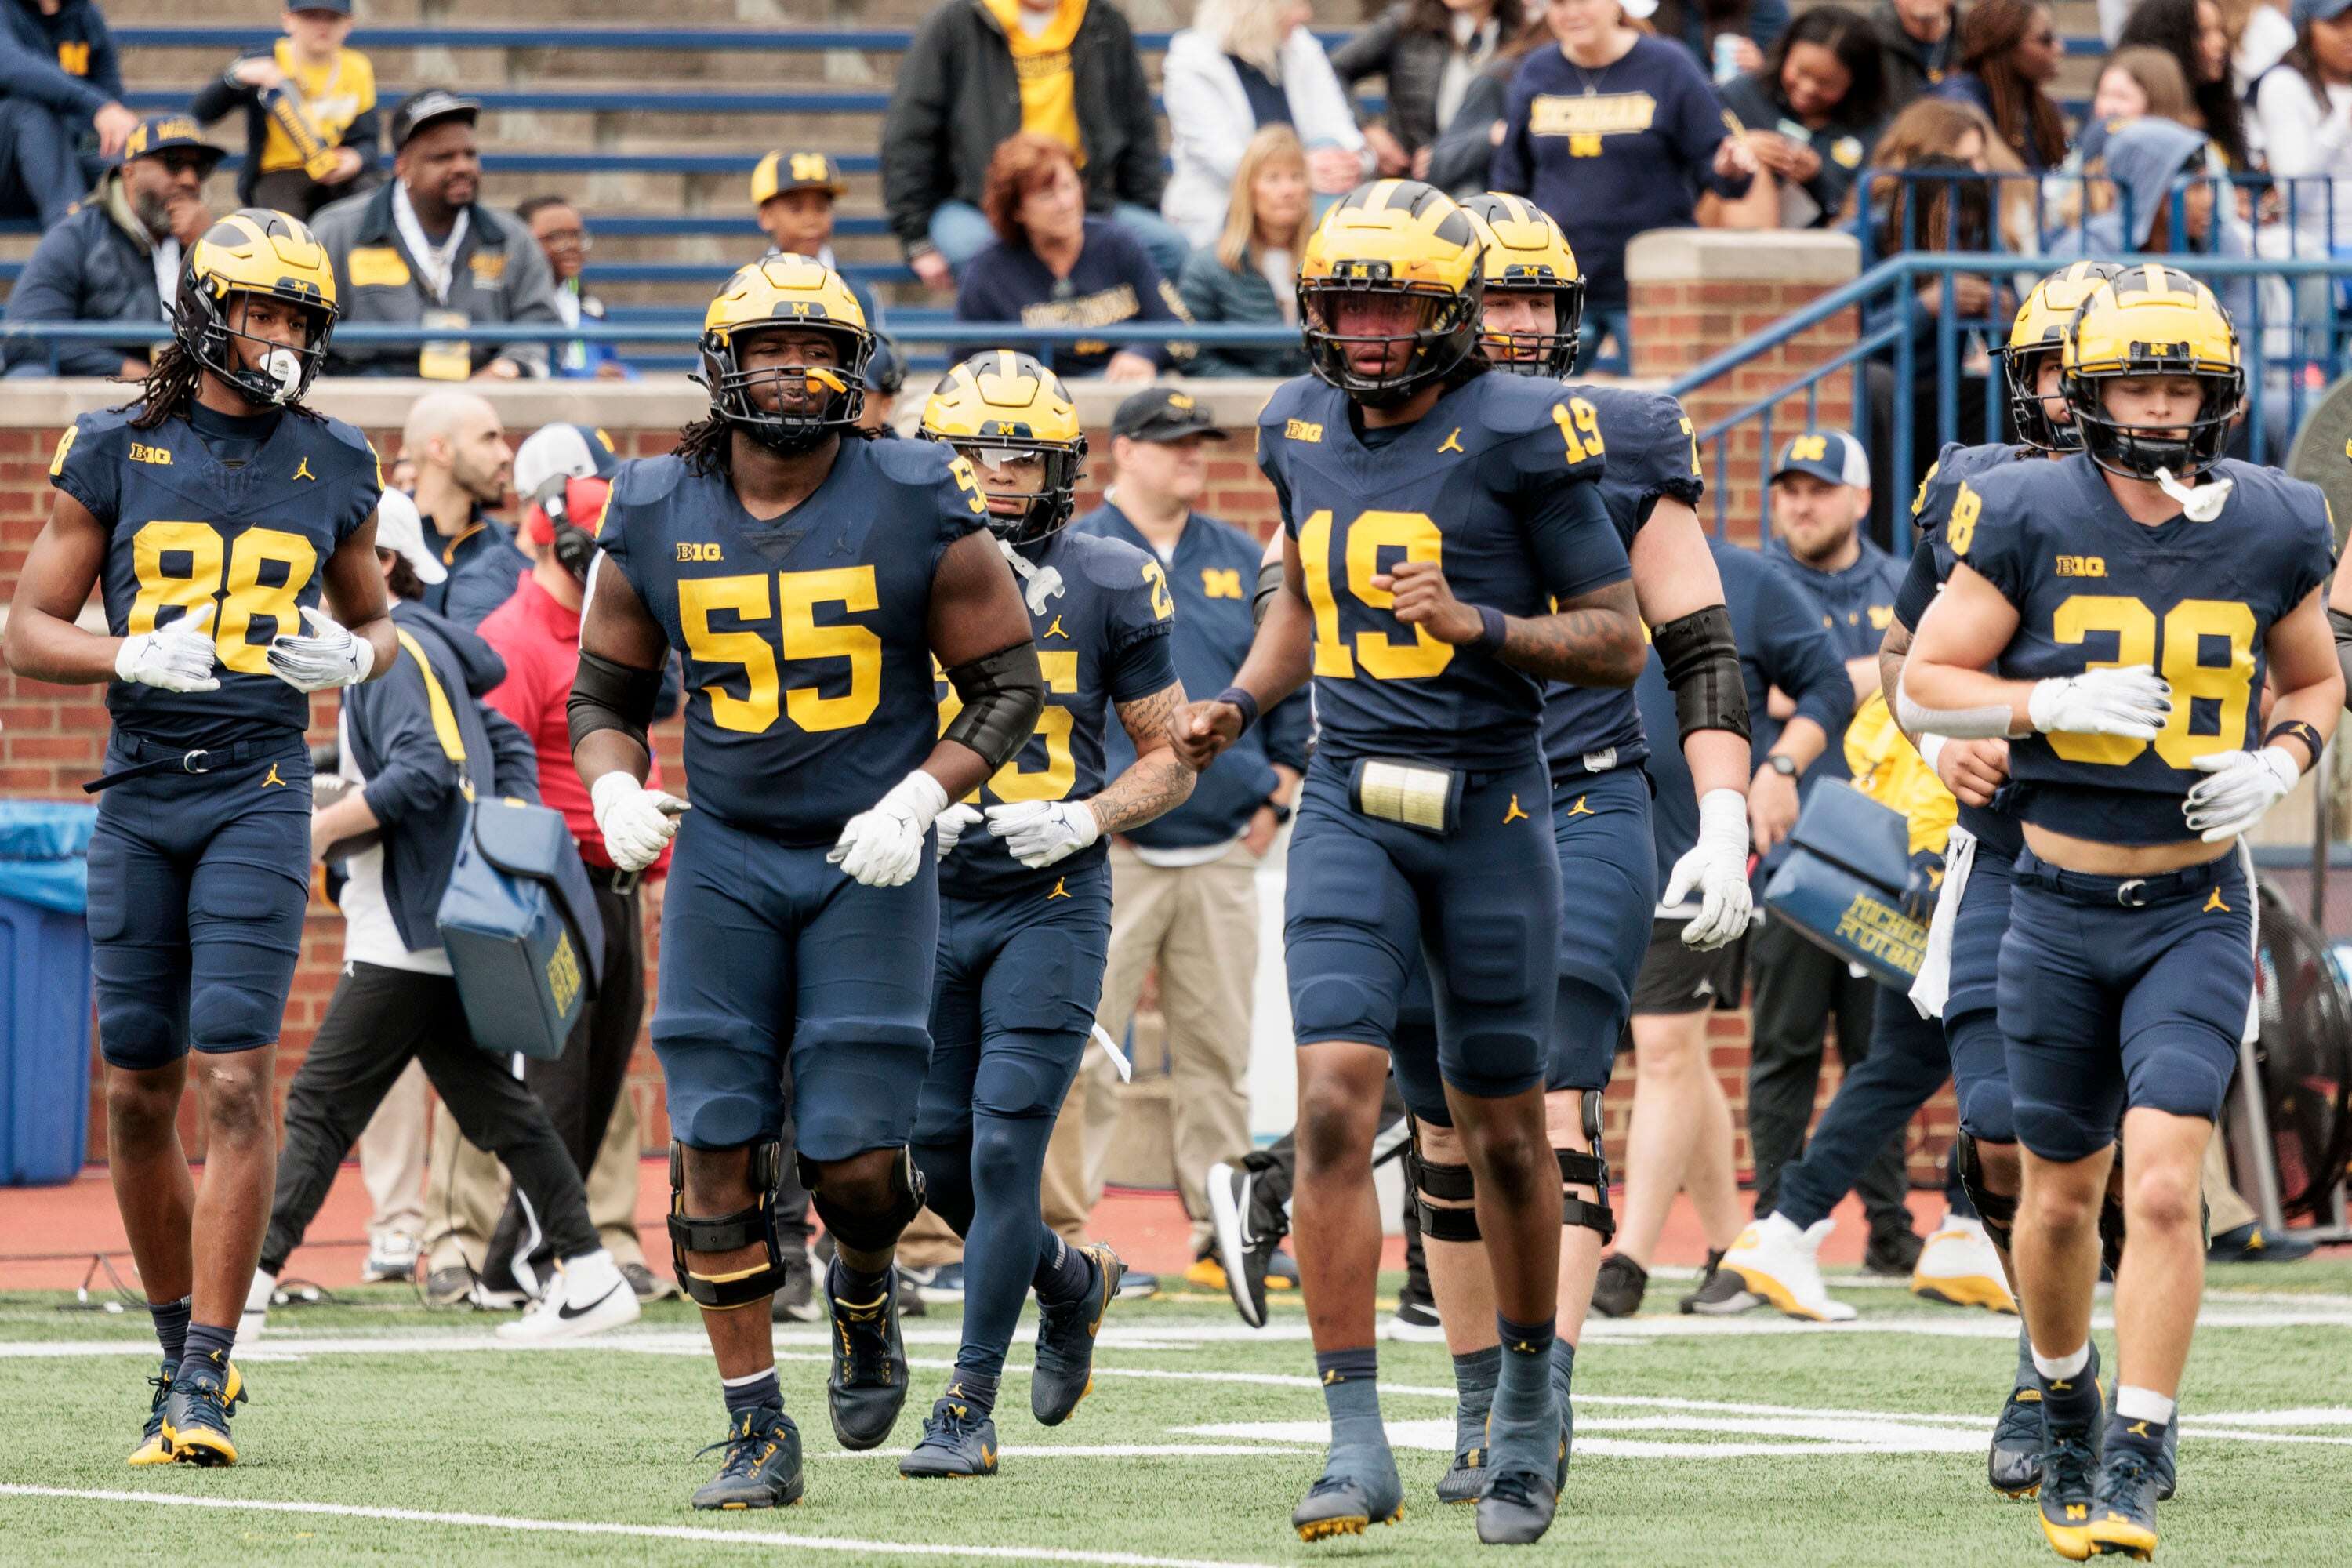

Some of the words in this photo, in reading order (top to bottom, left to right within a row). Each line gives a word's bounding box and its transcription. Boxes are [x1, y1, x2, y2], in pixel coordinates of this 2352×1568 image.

[790, 152, 829, 181] M
[1351, 265, 1368, 278] M
[1522, 265, 1540, 277] M
[294, 280, 309, 293] M
[791, 302, 809, 315] M
[2150, 343, 2168, 356] M
[997, 422, 1015, 436] M
[1552, 397, 1605, 465] 19
[1790, 434, 1827, 462] M
[1201, 568, 1243, 600] M
[1299, 510, 1455, 680] 19
[128, 521, 318, 674] 88
[677, 564, 883, 734] 55
[2066, 1503, 2088, 1521] M
